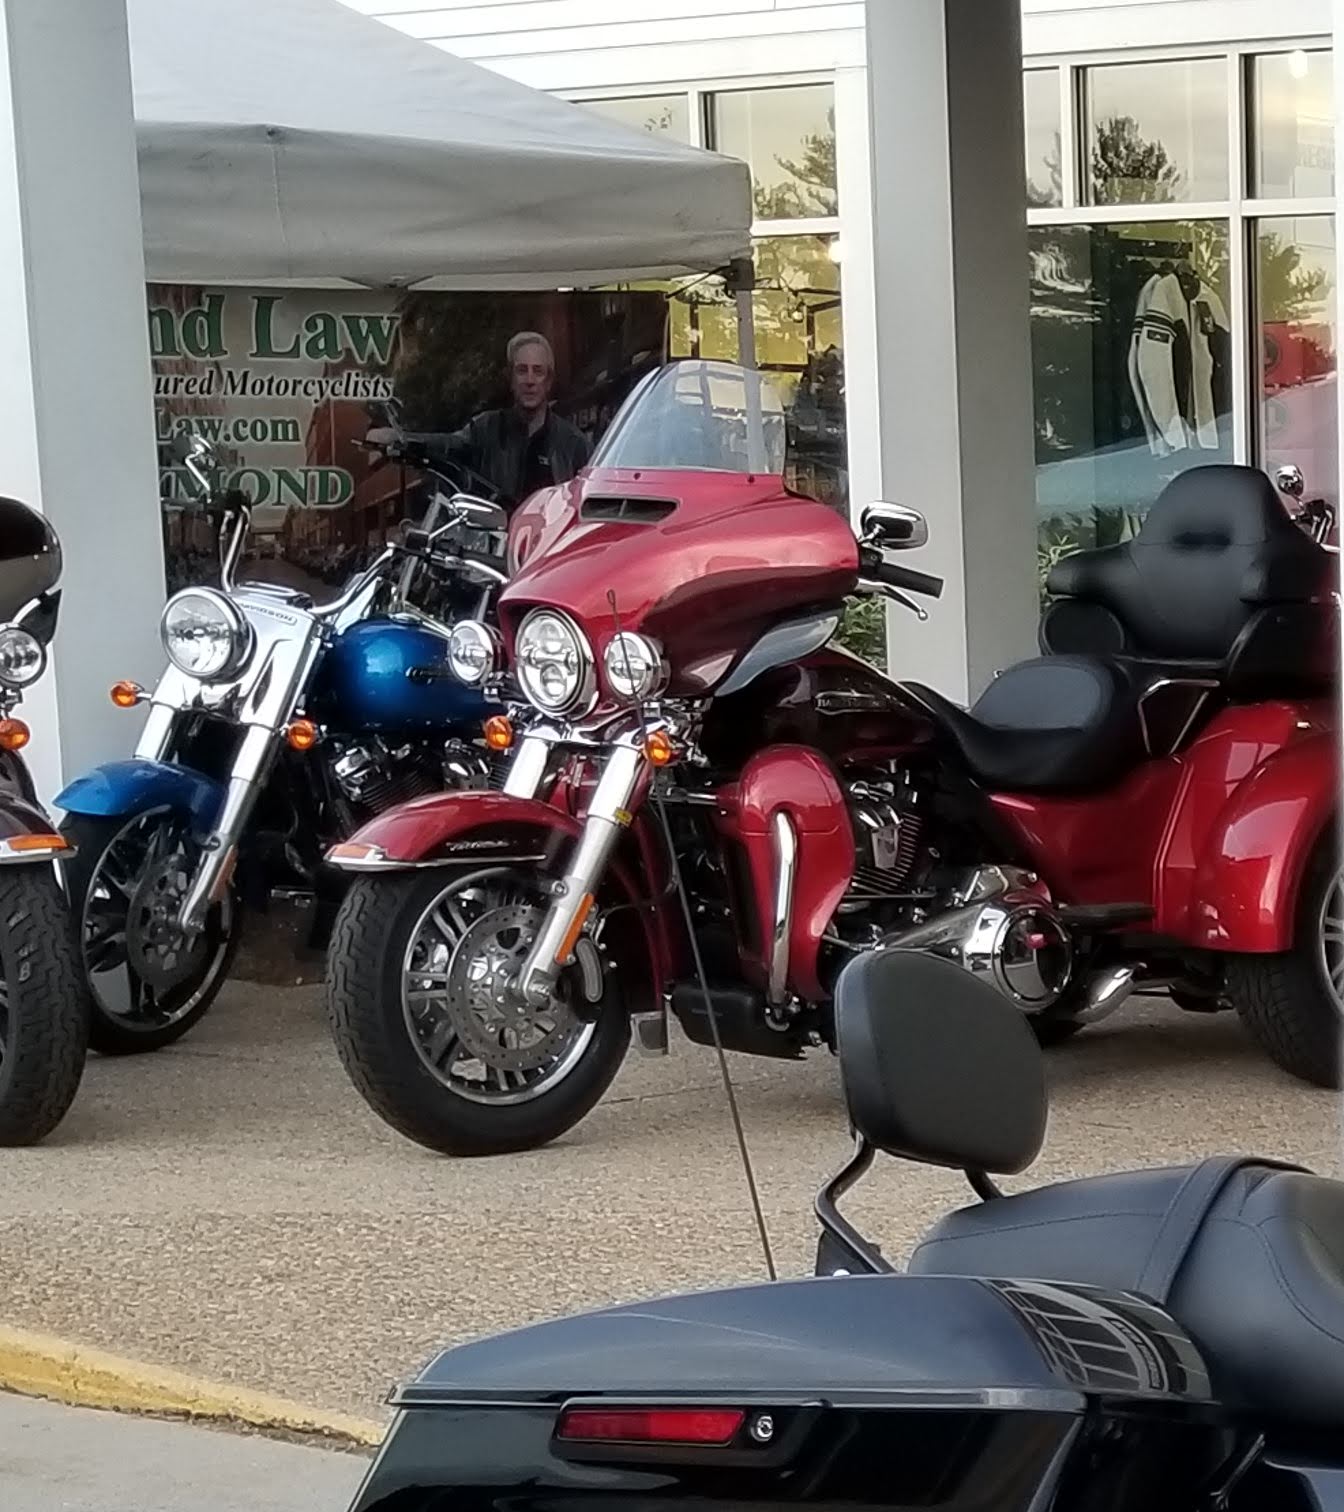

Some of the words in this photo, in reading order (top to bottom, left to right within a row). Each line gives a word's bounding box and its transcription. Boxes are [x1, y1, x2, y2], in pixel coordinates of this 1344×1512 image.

[148, 293, 228, 360] nd
[250, 296, 400, 364] Law
[154, 370, 215, 396] ured
[222, 370, 392, 405] Motorcyclists
[156, 408, 300, 442] Law.com
[160, 468, 353, 507] MOND
